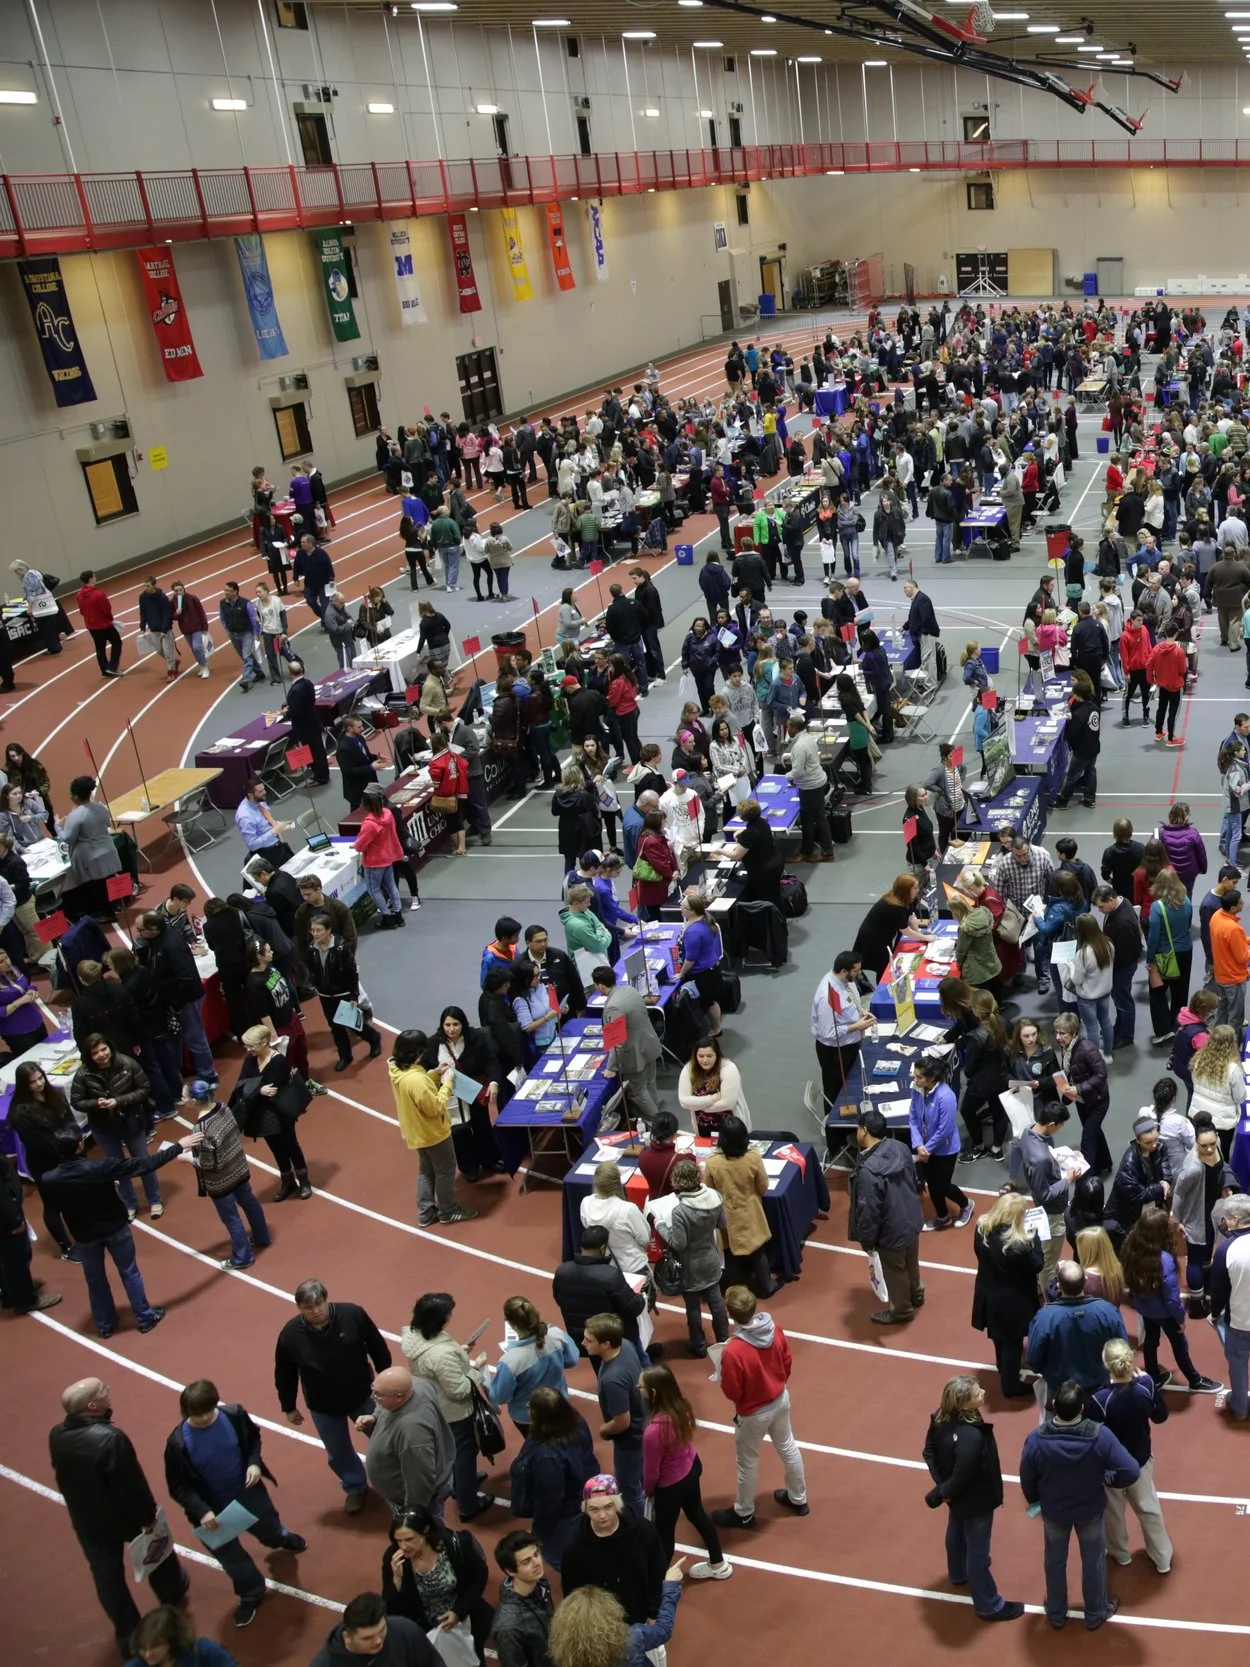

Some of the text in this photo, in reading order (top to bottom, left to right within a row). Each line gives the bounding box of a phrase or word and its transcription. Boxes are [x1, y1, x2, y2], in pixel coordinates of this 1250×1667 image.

[395, 254, 414, 276] M
[164, 348, 176, 359] ED
[1236, 1505, 1245, 1516] 75
